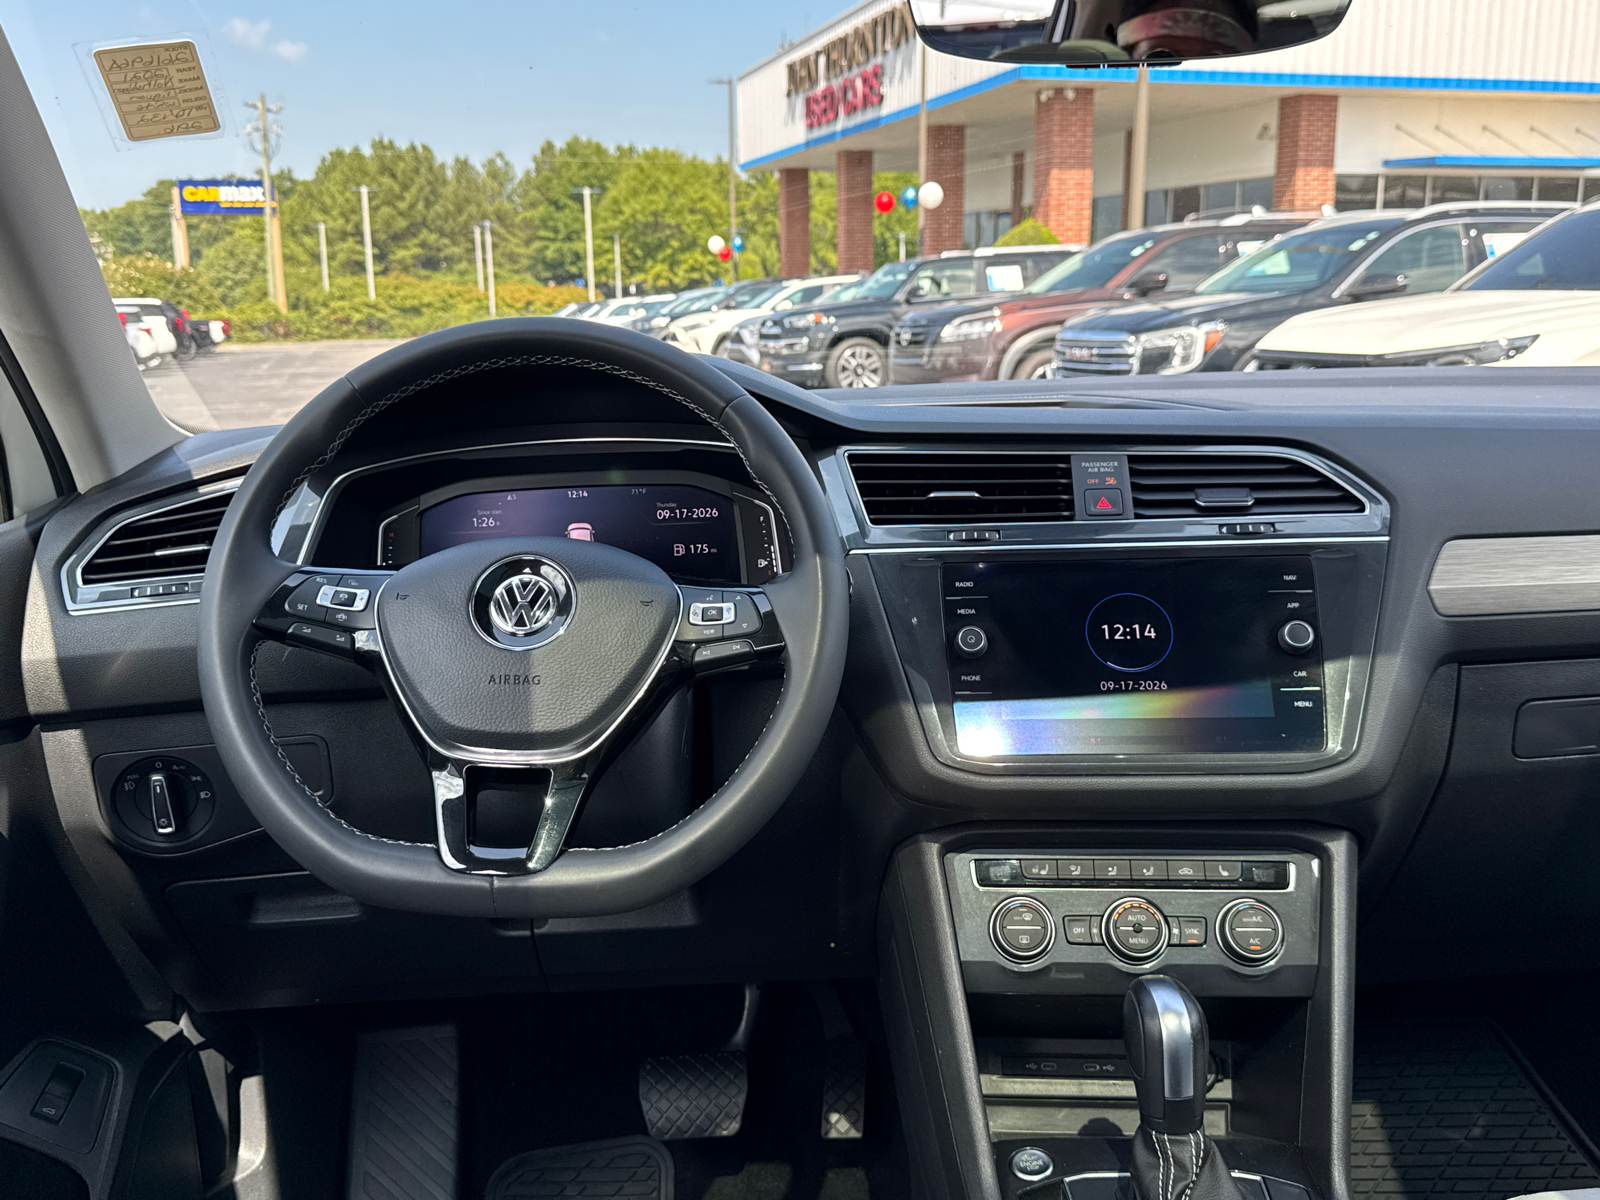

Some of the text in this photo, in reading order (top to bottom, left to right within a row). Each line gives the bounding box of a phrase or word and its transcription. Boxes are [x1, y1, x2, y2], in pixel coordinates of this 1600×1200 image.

[804, 64, 883, 128] USED CARS
[567, 490, 588, 498] 12:14
[656, 507, 719, 520] 09-17-2026
[472, 517, 496, 527] 1:26
[689, 544, 709, 554] 175
[296, 603, 309, 612] SET
[1101, 623, 1157, 640] 12:14
[487, 674, 541, 686] AIRBAG
[1100, 680, 1168, 691] 09-17-2026
[1127, 914, 1147, 922] AUTO
